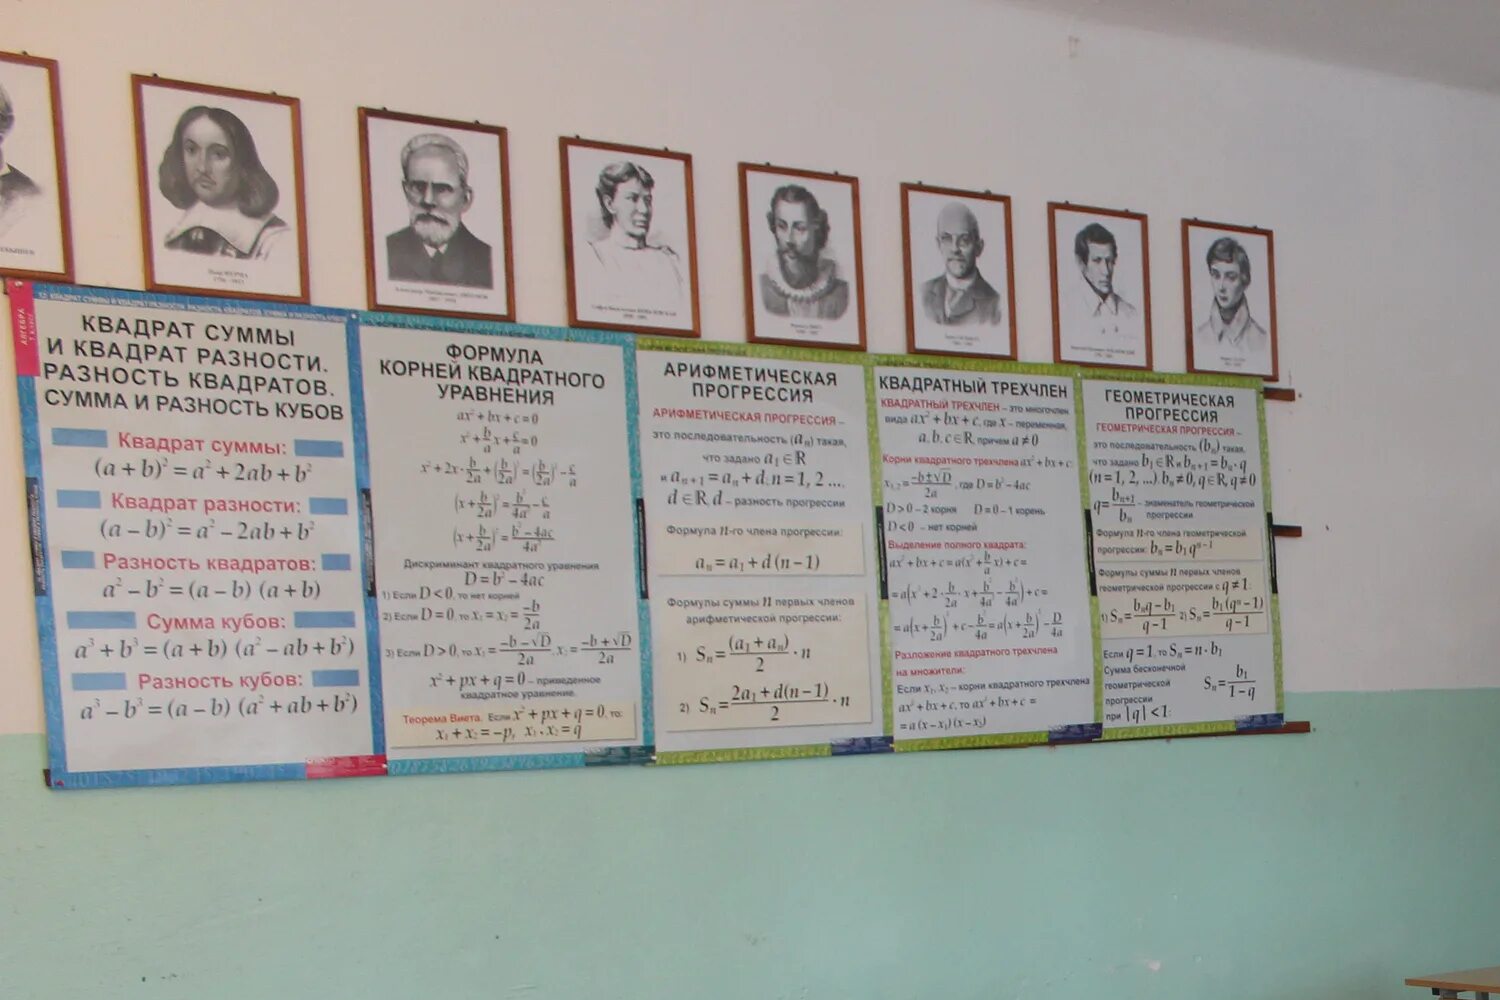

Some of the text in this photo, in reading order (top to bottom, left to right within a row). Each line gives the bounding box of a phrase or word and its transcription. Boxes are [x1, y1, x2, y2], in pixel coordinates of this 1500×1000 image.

[82, 315, 295, 346] КВАДРАТ СУММЫ
[47, 338, 328, 373] И КВАДРАТ РАЗНОСТИ.
[446, 343, 544, 365] ФОРМУЛА
[44, 362, 335, 397] РАЗНОСТЬ КВАДРАТОВ.
[380, 359, 605, 389] КОРНЕЙ КВАДРАТНОГО
[663, 362, 837, 386] АРИФМЕТИЧЕСКАЯ
[692, 382, 813, 403] ПРОГРЕССИЯ
[879, 375, 1068, 398] КВАДРАТНЫЙ ТРЕХЧЛЕН
[437, 384, 555, 405] УРАВНЕНИЯ
[1105, 389, 1235, 408] ГЕОМЕТРИЧЕСКАЯ
[45, 389, 344, 421] СУММА И РАЗНОСТЬ КУБОВ
[880, 400, 949, 411] КВАДРАТНЫЙ
[952, 401, 1000, 412] ТРЕХЧЛЕН
[653, 408, 836, 426] АРИФМЕТИЧЕСКАЯ ПРОГРЕССИЯ
[1126, 407, 1218, 423] ПРОГРЕССИЯ
[1096, 423, 1235, 436] ГЕОМЕТРИЧЕСКАЯ ПРОГРЕССИЯ
[118, 432, 287, 457] Квадрат суммы:
[653, 431, 671, 439] это
[674, 432, 788, 445] последовательность
[1110, 442, 1197, 451] последовательность
[723, 455, 760, 465] задано
[883, 453, 1019, 467] Корни квадратного трехчлена
[112, 493, 301, 515] Квадрат разности:
[735, 497, 846, 508] разность прогрессии
[1147, 511, 1193, 519] прогрессии
[666, 526, 717, 536] Формула
[746, 528, 778, 536] члена
[1096, 529, 1134, 538] Формула
[1183, 529, 1247, 538] геометрической
[888, 540, 942, 550] Выделение
[945, 541, 981, 550] полного
[103, 553, 316, 574] Разность квадратов:
[403, 560, 479, 569] Дискриминант
[482, 562, 545, 570] квадратного
[1099, 569, 1138, 577] Формулы
[1100, 583, 1213, 592] геометрической прогрессии
[666, 597, 721, 609] Формулы
[723, 599, 760, 608] суммы
[775, 599, 814, 607] первых
[147, 614, 286, 633] Сумма кубов:
[686, 614, 776, 624] арифметической
[678, 651, 687, 663] 1)
[895, 646, 1058, 660] Разложение квадратного трехчлена
[1104, 650, 1124, 659] Если
[1104, 664, 1186, 675] Сумма бесконечной
[138, 672, 302, 691] Разность кубов:
[897, 677, 1091, 694] Если корни квадратного трехчлена
[1105, 681, 1170, 690] геометрической
[460, 691, 519, 700] квадратное
[1105, 696, 1153, 705] прогрессии
[680, 703, 690, 714] 2)
[403, 714, 447, 723] Теорема
[1106, 712, 1121, 721] при
